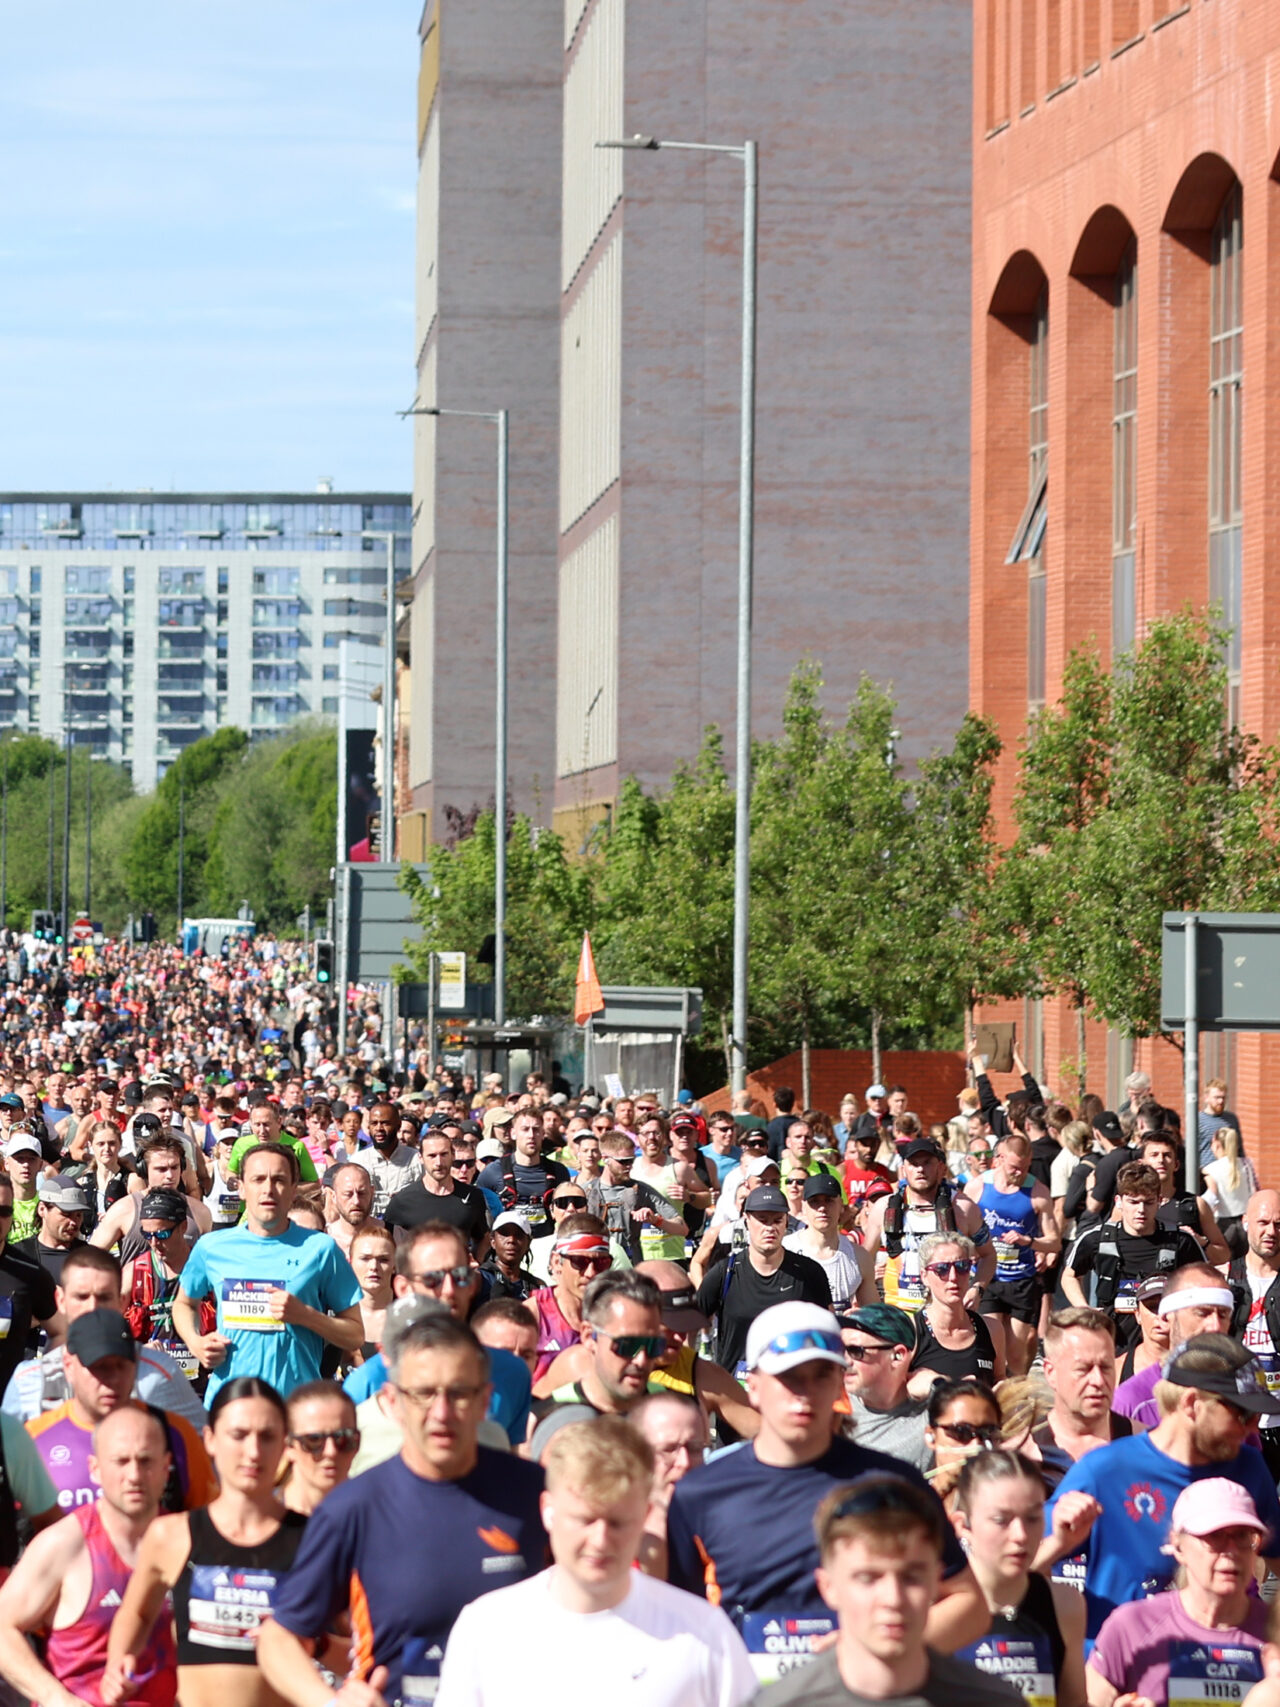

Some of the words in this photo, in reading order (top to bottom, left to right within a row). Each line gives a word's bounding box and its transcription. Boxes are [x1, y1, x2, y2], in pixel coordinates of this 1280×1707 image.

[239, 1304, 266, 1314] 11189
[214, 1587, 270, 1606] ELYSIA
[1205, 1662, 1240, 1677] CAT
[1203, 1682, 1241, 1698] 11118
